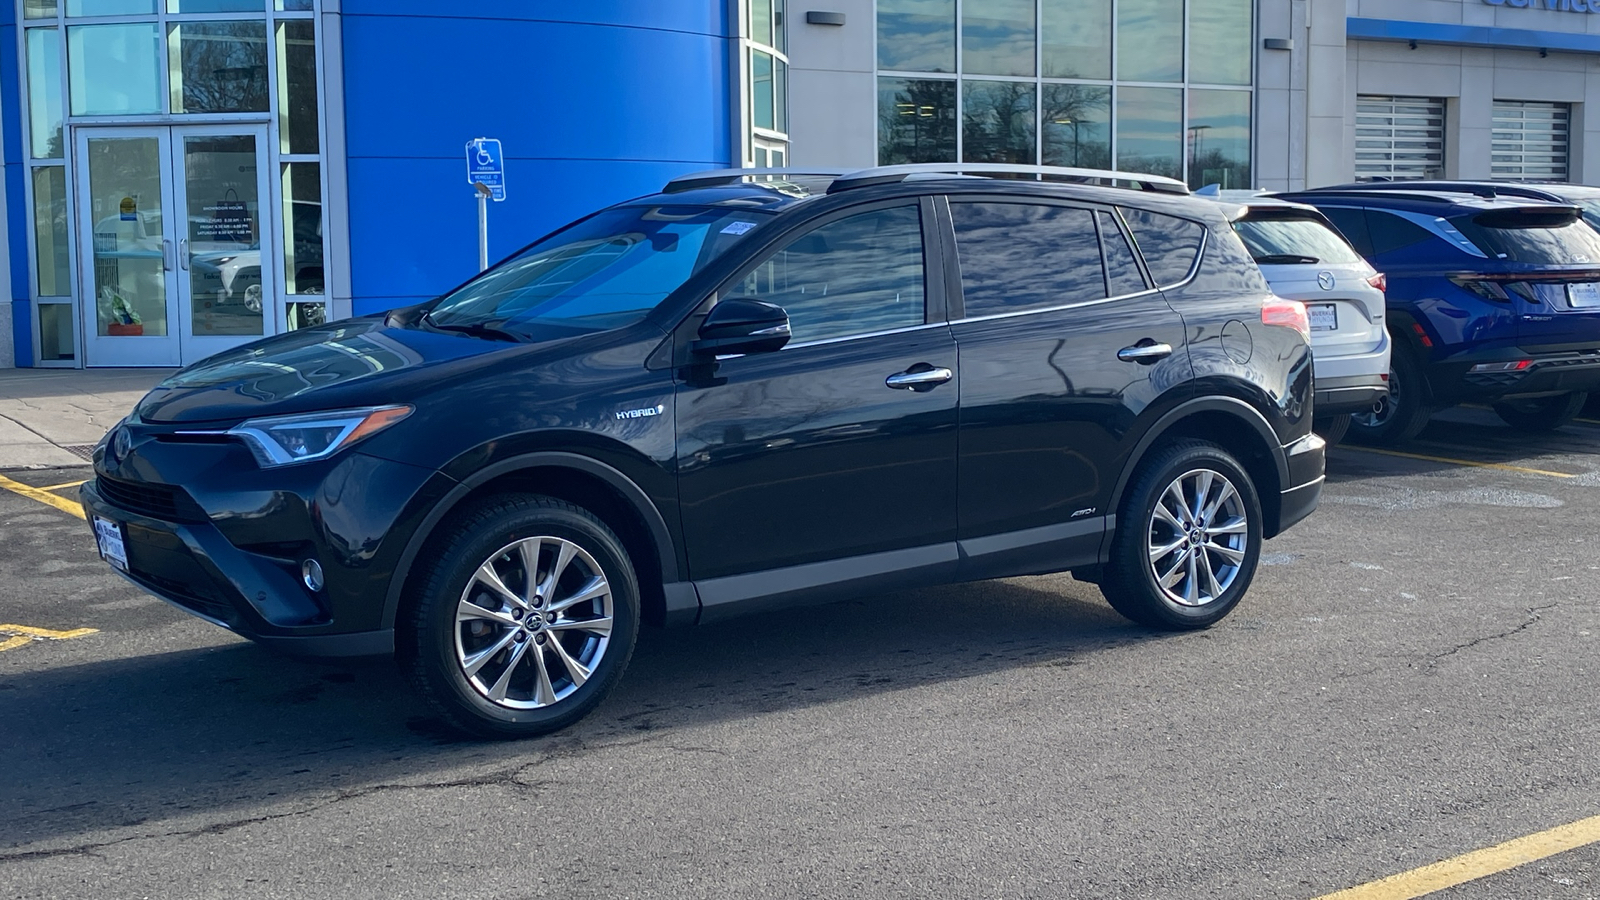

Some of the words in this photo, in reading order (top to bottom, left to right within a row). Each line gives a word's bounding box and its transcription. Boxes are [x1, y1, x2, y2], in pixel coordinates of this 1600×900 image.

[1482, 0, 1600, 13] rvice
[616, 408, 656, 420] HYBRID
[104, 524, 122, 541] BUERKL
